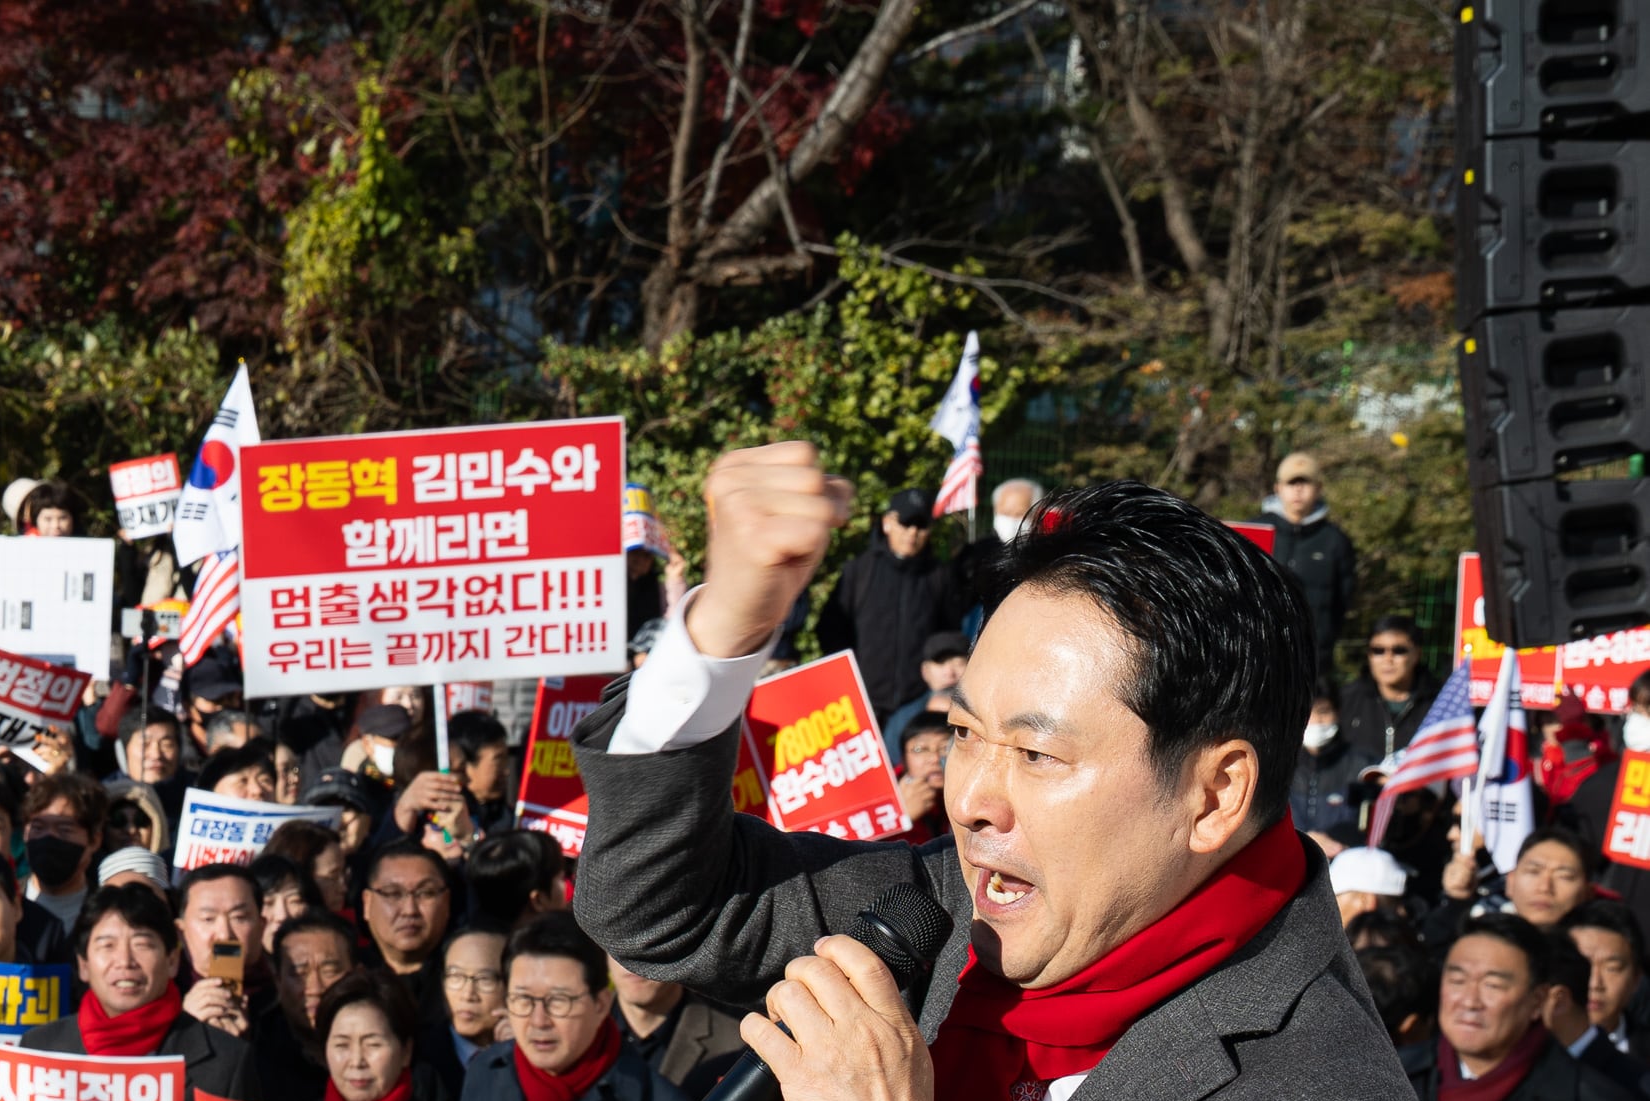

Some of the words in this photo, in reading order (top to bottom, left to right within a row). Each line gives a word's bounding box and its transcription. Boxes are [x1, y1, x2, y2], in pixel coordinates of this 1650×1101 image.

[257, 456, 398, 513] 장동혁
[411, 443, 600, 504] 김민수와
[342, 509, 530, 569] 함께라면
[267, 637, 373, 673] 우리는
[386, 627, 490, 666] 끝까지
[504, 621, 608, 659] 간다!!!
[190, 818, 248, 843] 대장동
